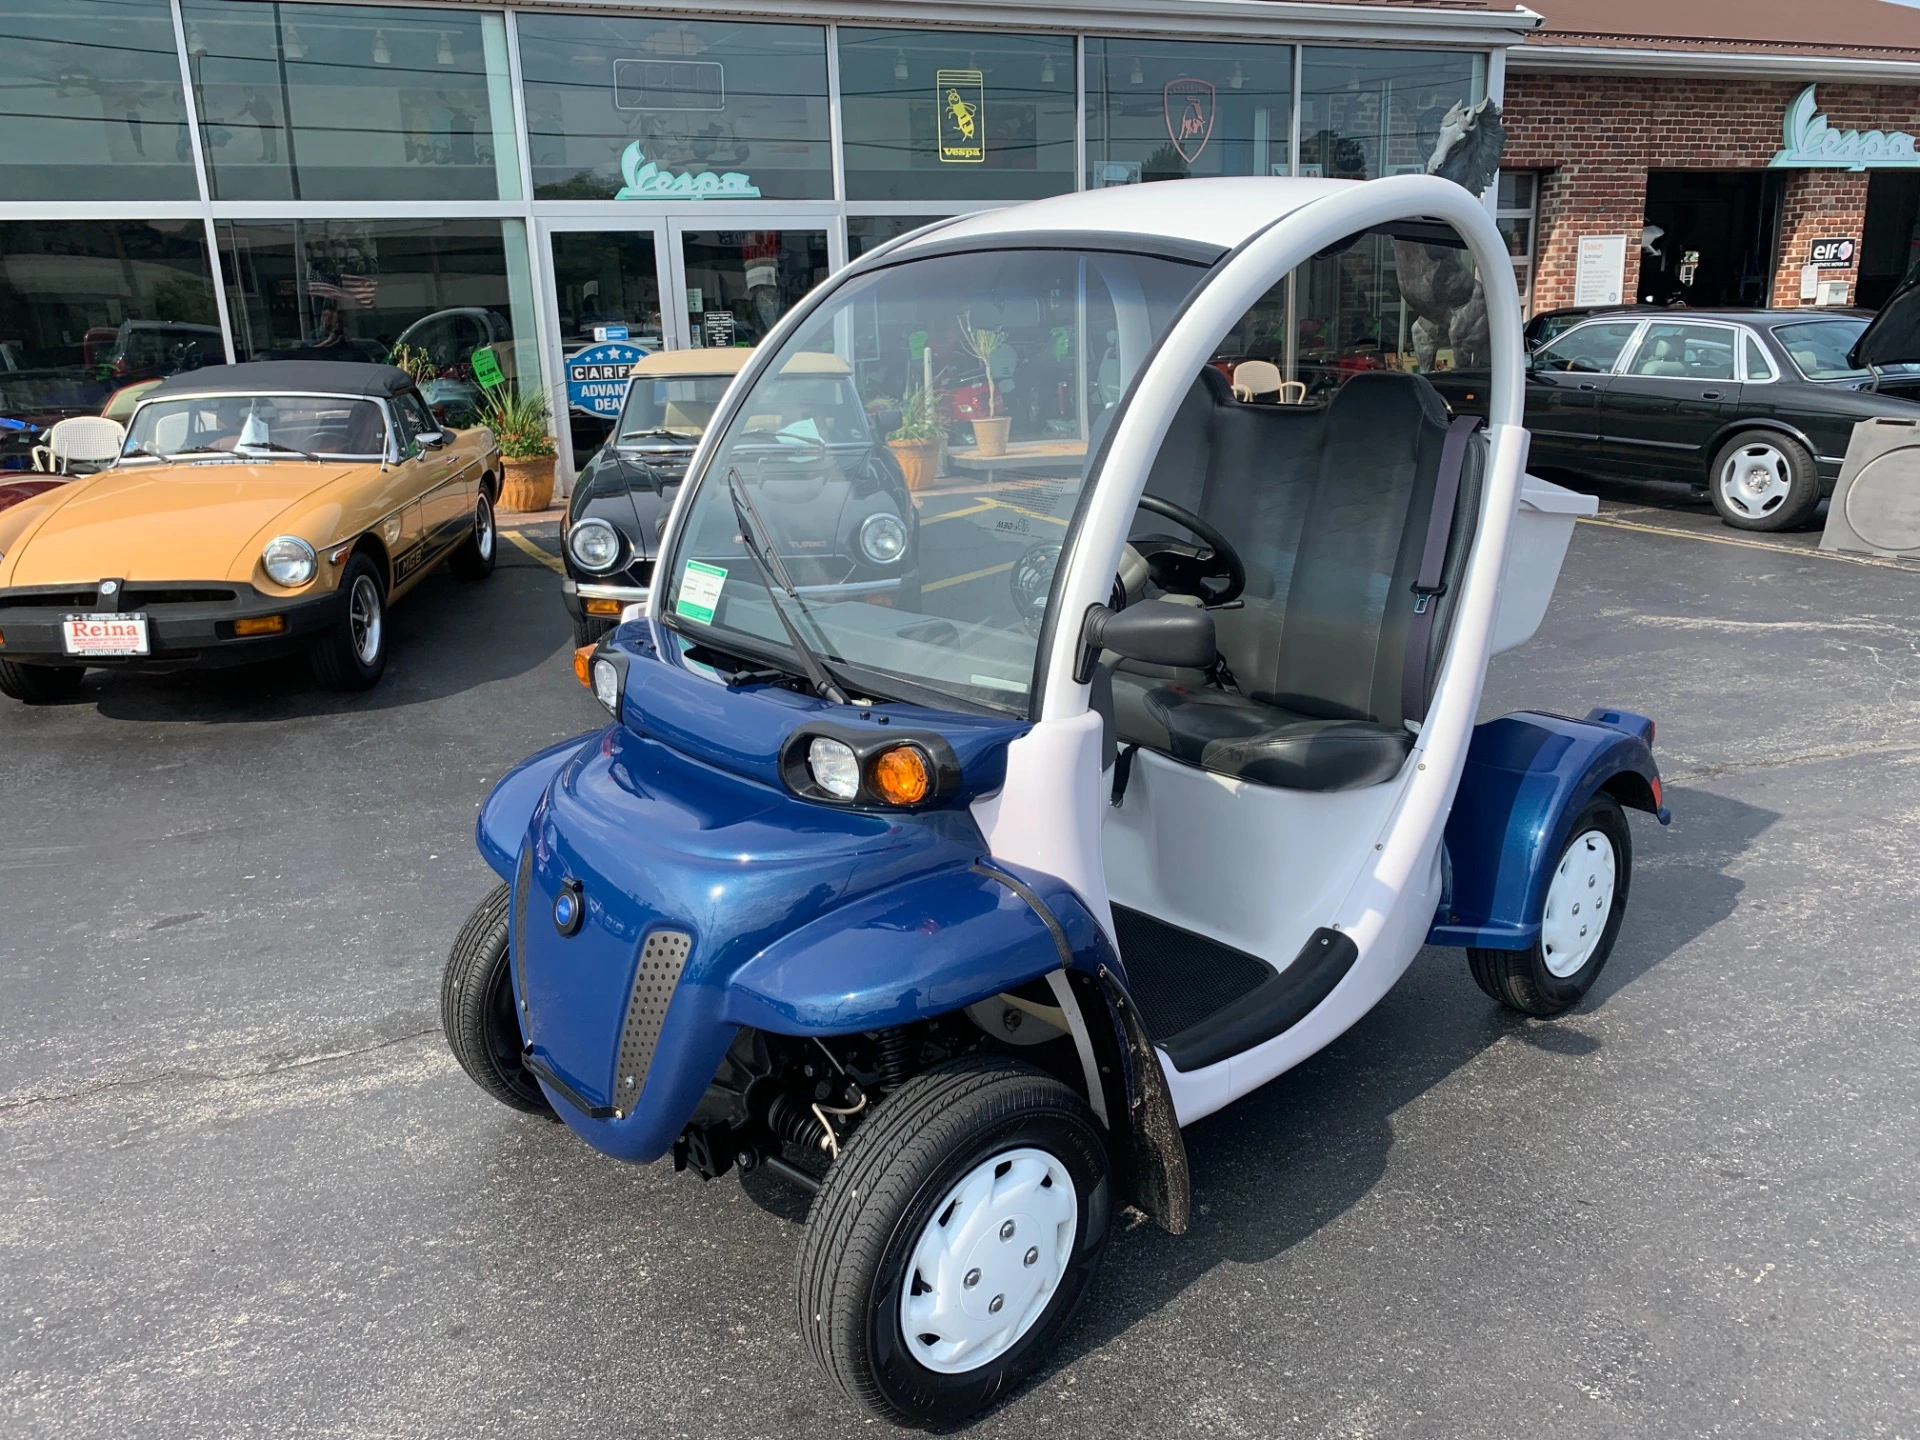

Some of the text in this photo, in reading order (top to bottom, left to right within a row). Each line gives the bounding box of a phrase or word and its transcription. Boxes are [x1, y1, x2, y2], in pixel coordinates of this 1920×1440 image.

[619, 64, 720, 106] OPEN
[1775, 83, 1918, 170] Vespa
[943, 148, 981, 158] Vespa
[617, 140, 760, 200] Vespa
[1813, 243, 1839, 259] elf
[574, 366, 628, 380] CARF
[581, 383, 628, 397] ADVAN
[594, 398, 622, 411] DEA
[72, 620, 138, 637] Reina
